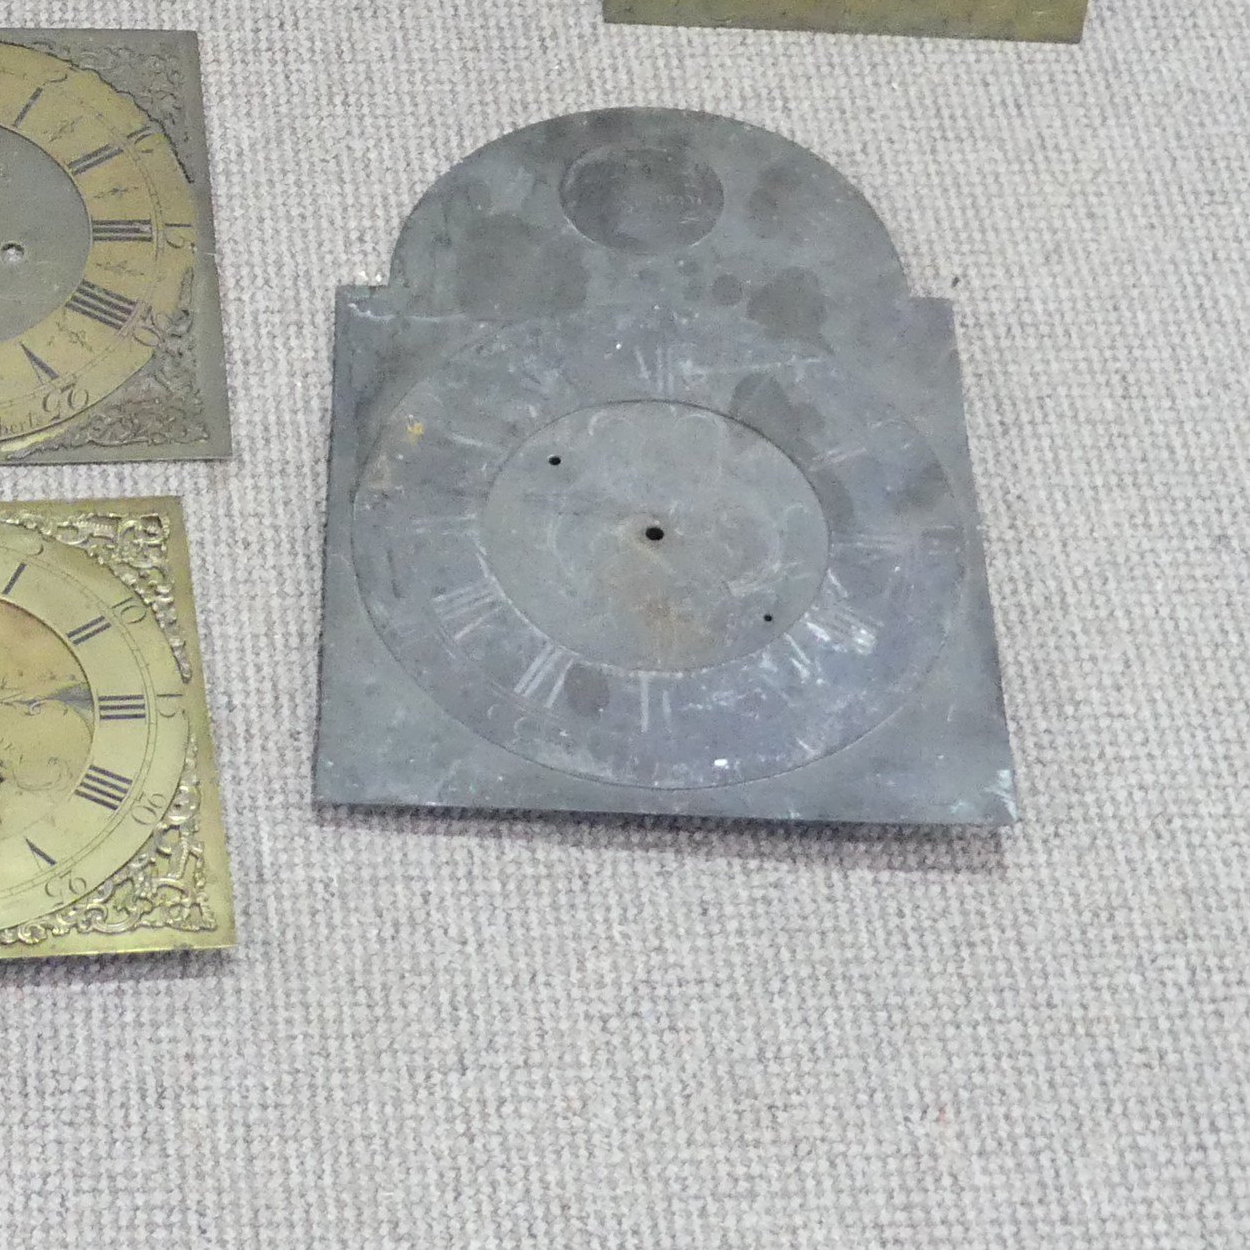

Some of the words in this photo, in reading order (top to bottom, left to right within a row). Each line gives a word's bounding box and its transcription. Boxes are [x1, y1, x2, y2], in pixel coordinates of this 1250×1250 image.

[11, 85, 45, 129] I
[65, 141, 126, 175] II
[89, 217, 154, 243] III
[63, 279, 140, 333] IIII
[3, 562, 28, 596] I
[66, 613, 113, 647] II
[97, 693, 148, 721] III
[71, 763, 135, 812] IIII
